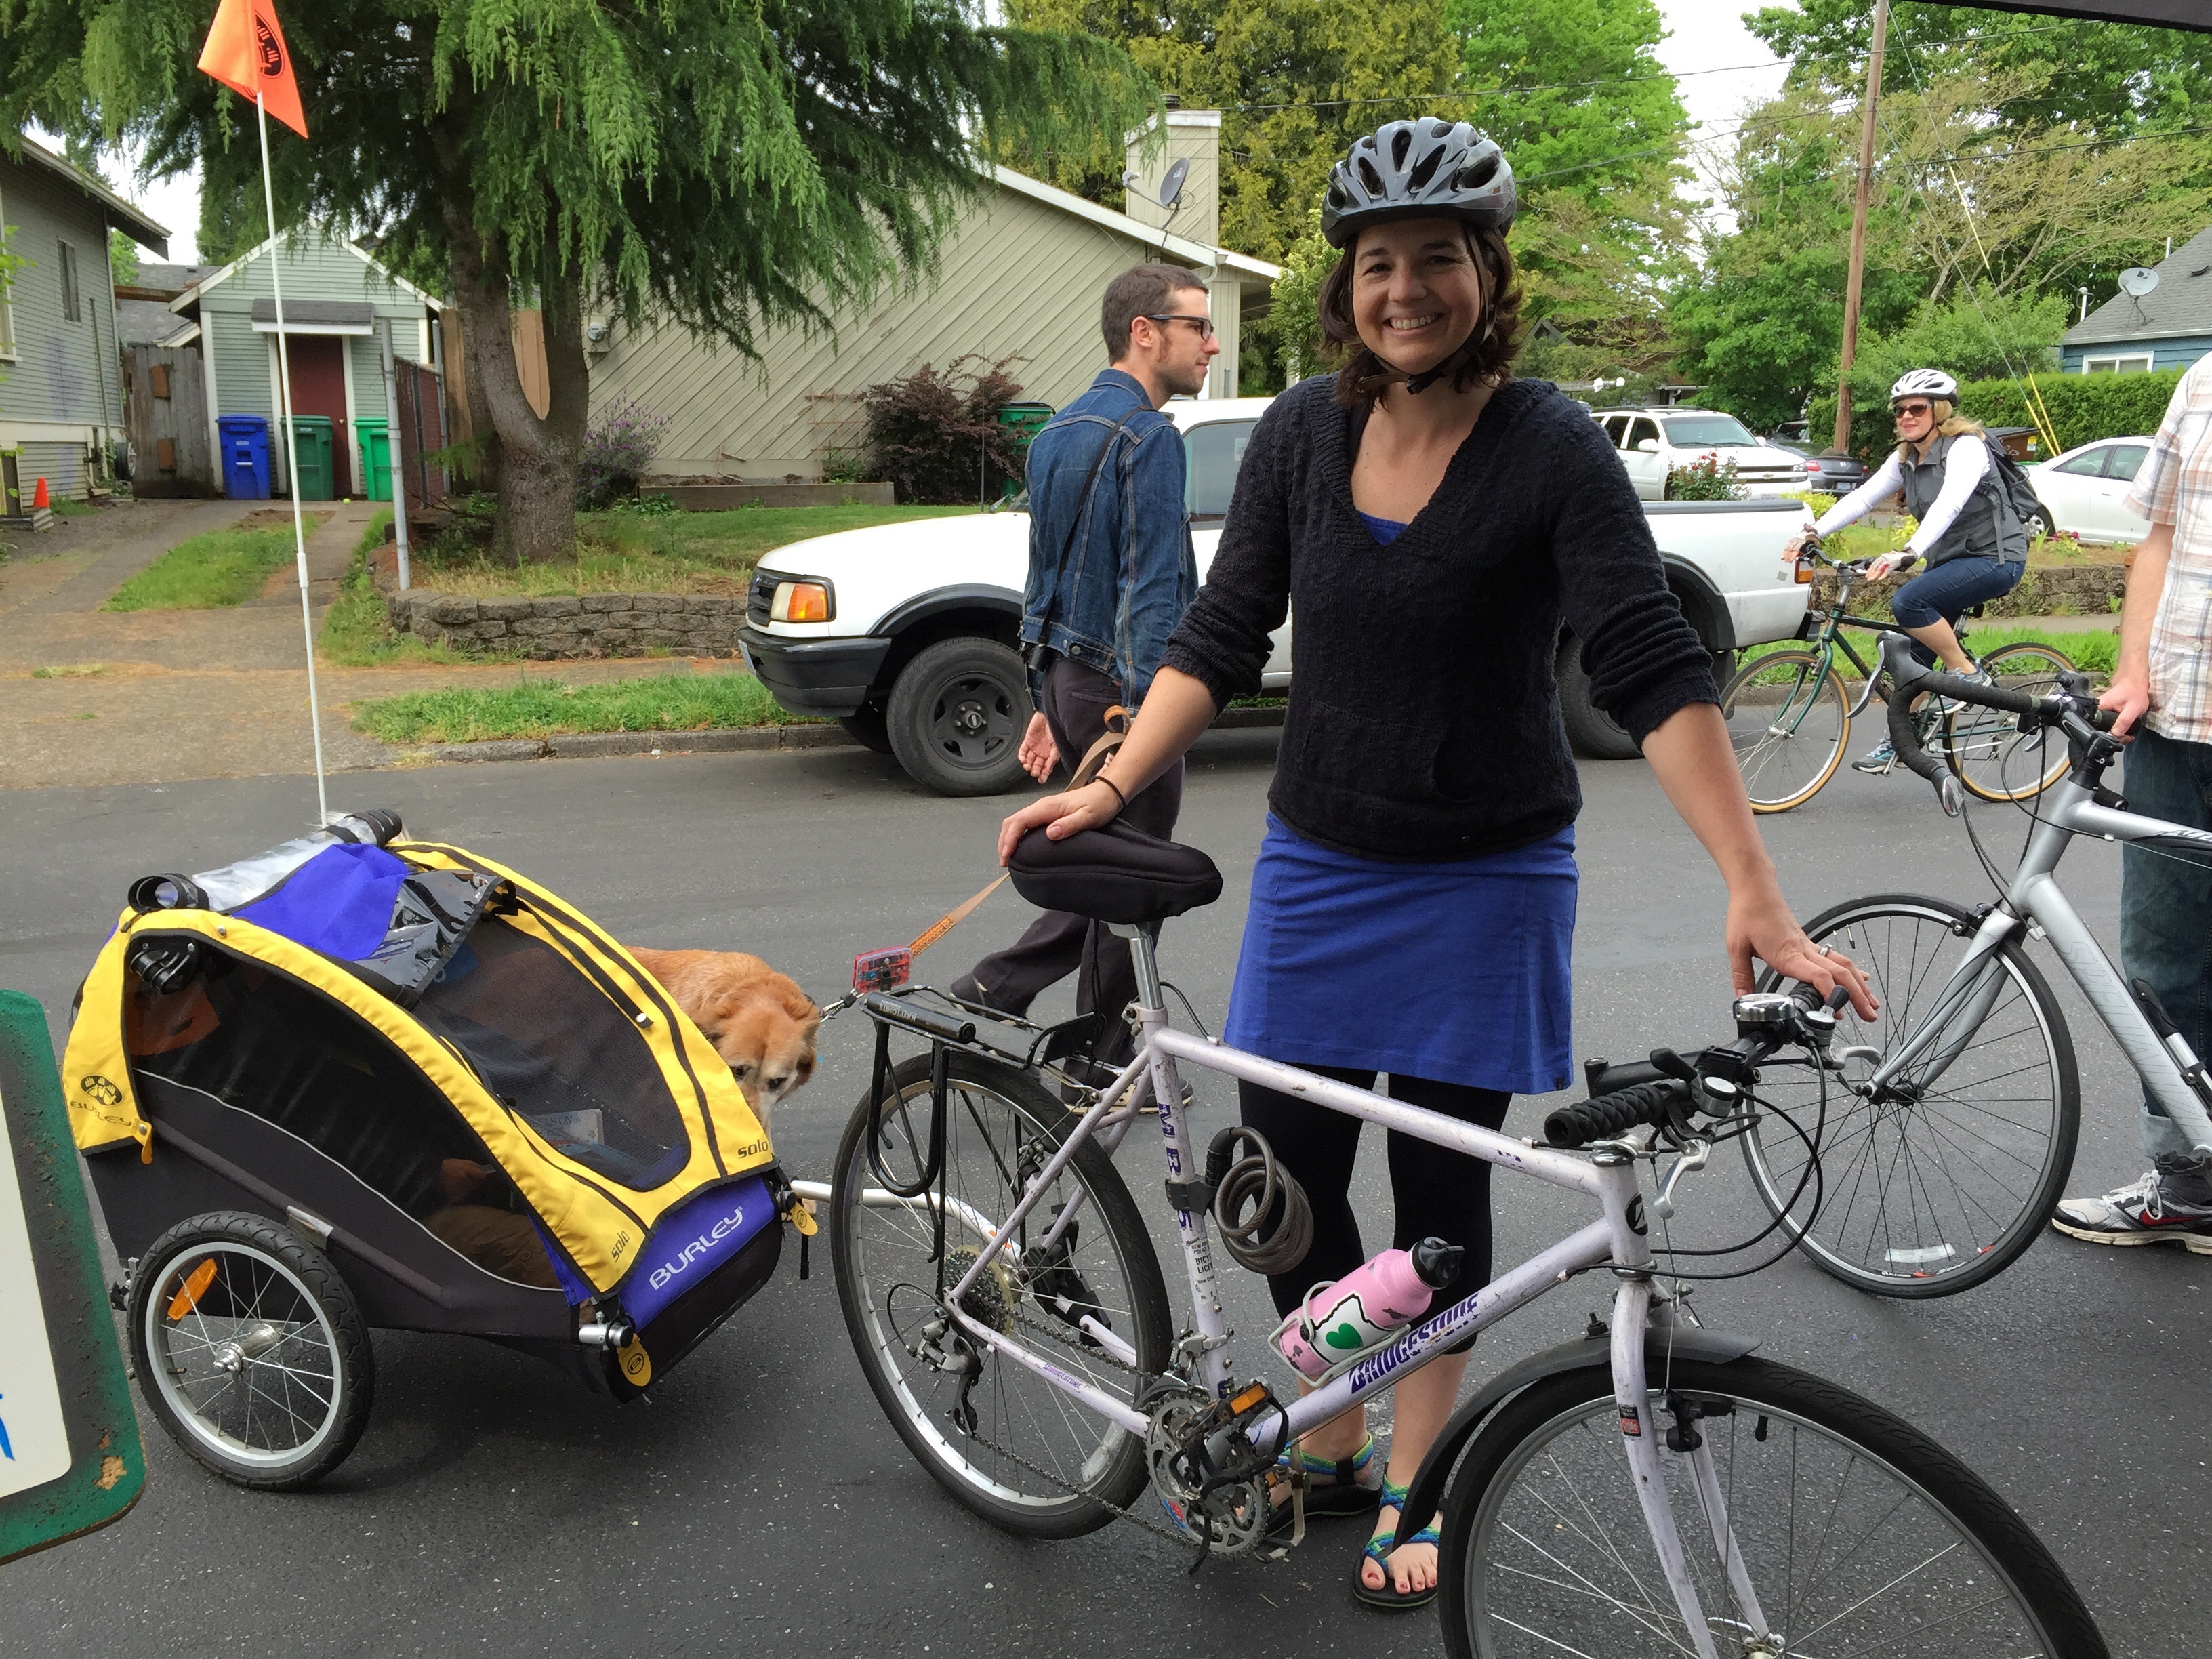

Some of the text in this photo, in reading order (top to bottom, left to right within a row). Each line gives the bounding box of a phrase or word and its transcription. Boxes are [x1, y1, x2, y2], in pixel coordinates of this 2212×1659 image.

[2061, 941, 2212, 1143] SPECIALIZE
[737, 1139, 769, 1160] solo
[611, 1229, 630, 1263] solo
[649, 1208, 743, 1290] BURLEY
